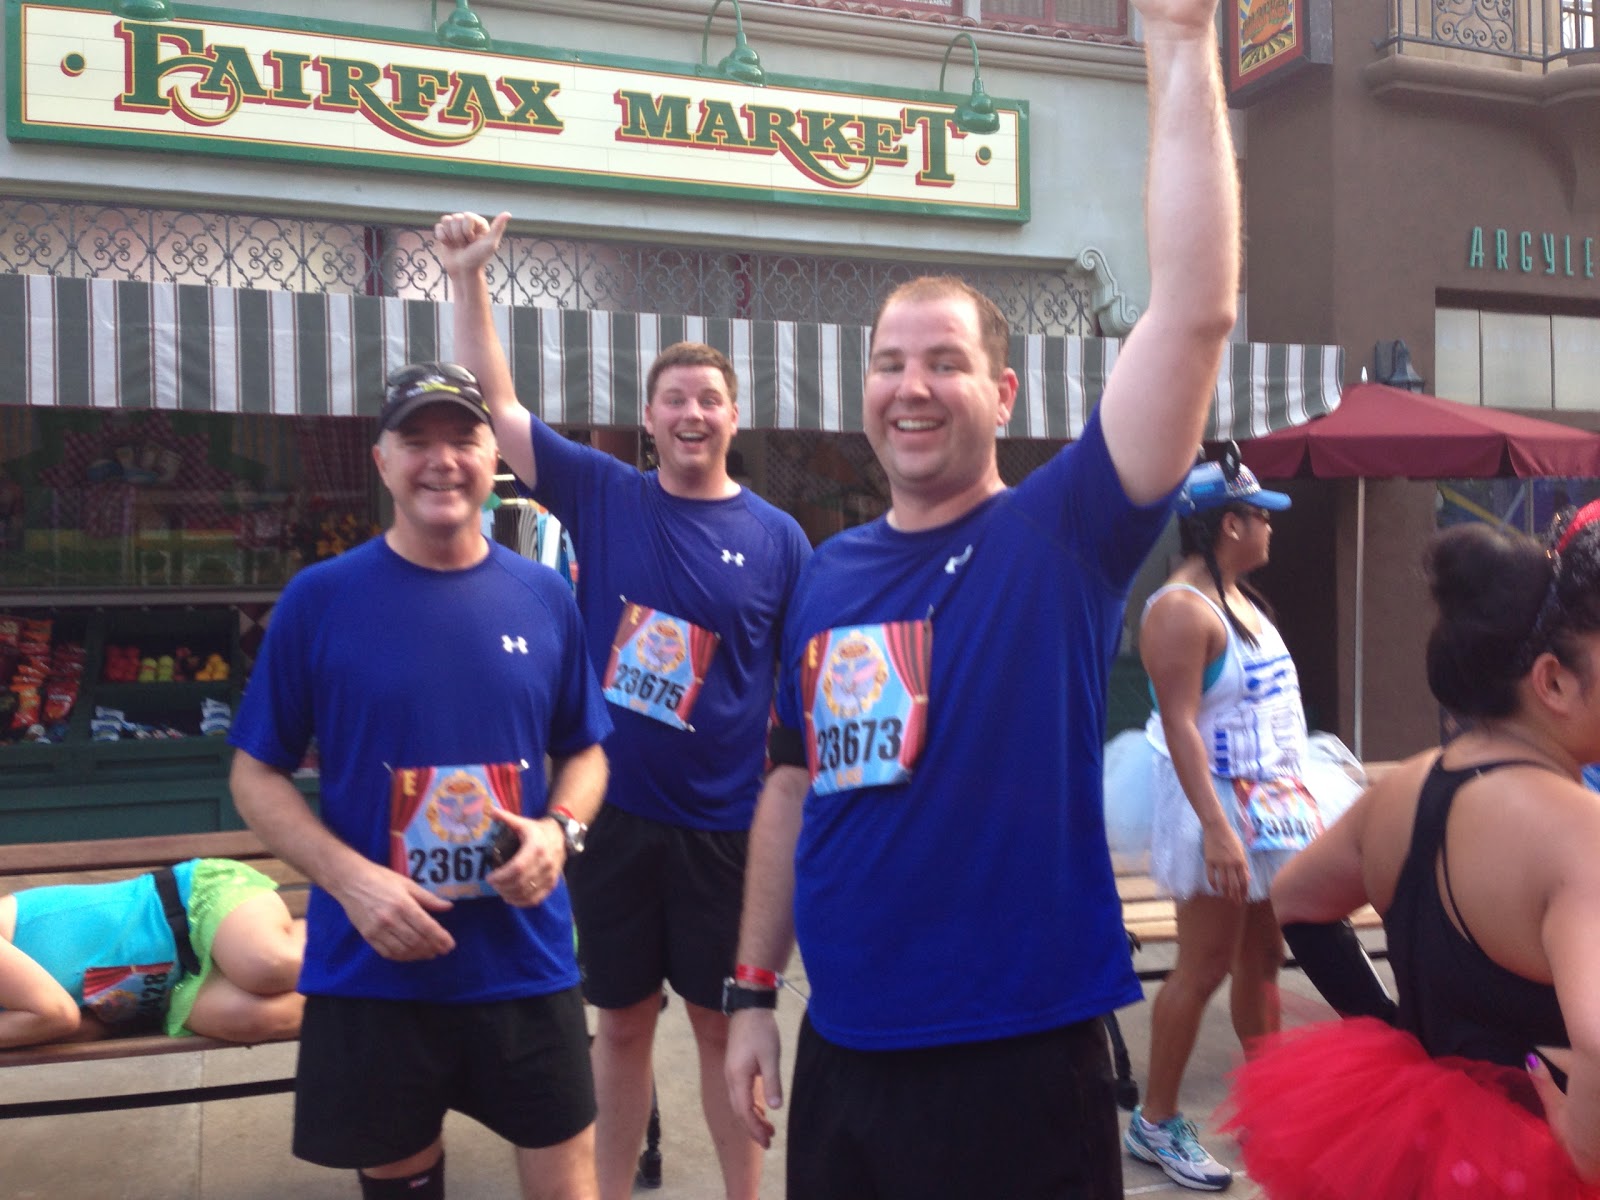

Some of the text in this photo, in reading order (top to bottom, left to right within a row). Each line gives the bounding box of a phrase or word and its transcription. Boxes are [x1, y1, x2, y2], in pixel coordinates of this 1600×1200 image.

[114, 19, 968, 189] FAIRFAX MARKET
[1469, 226, 1594, 279] ARGYLE
[611, 664, 686, 711] 23675
[817, 716, 903, 772] 23673
[402, 769, 417, 797] E
[409, 846, 493, 884] 2367
